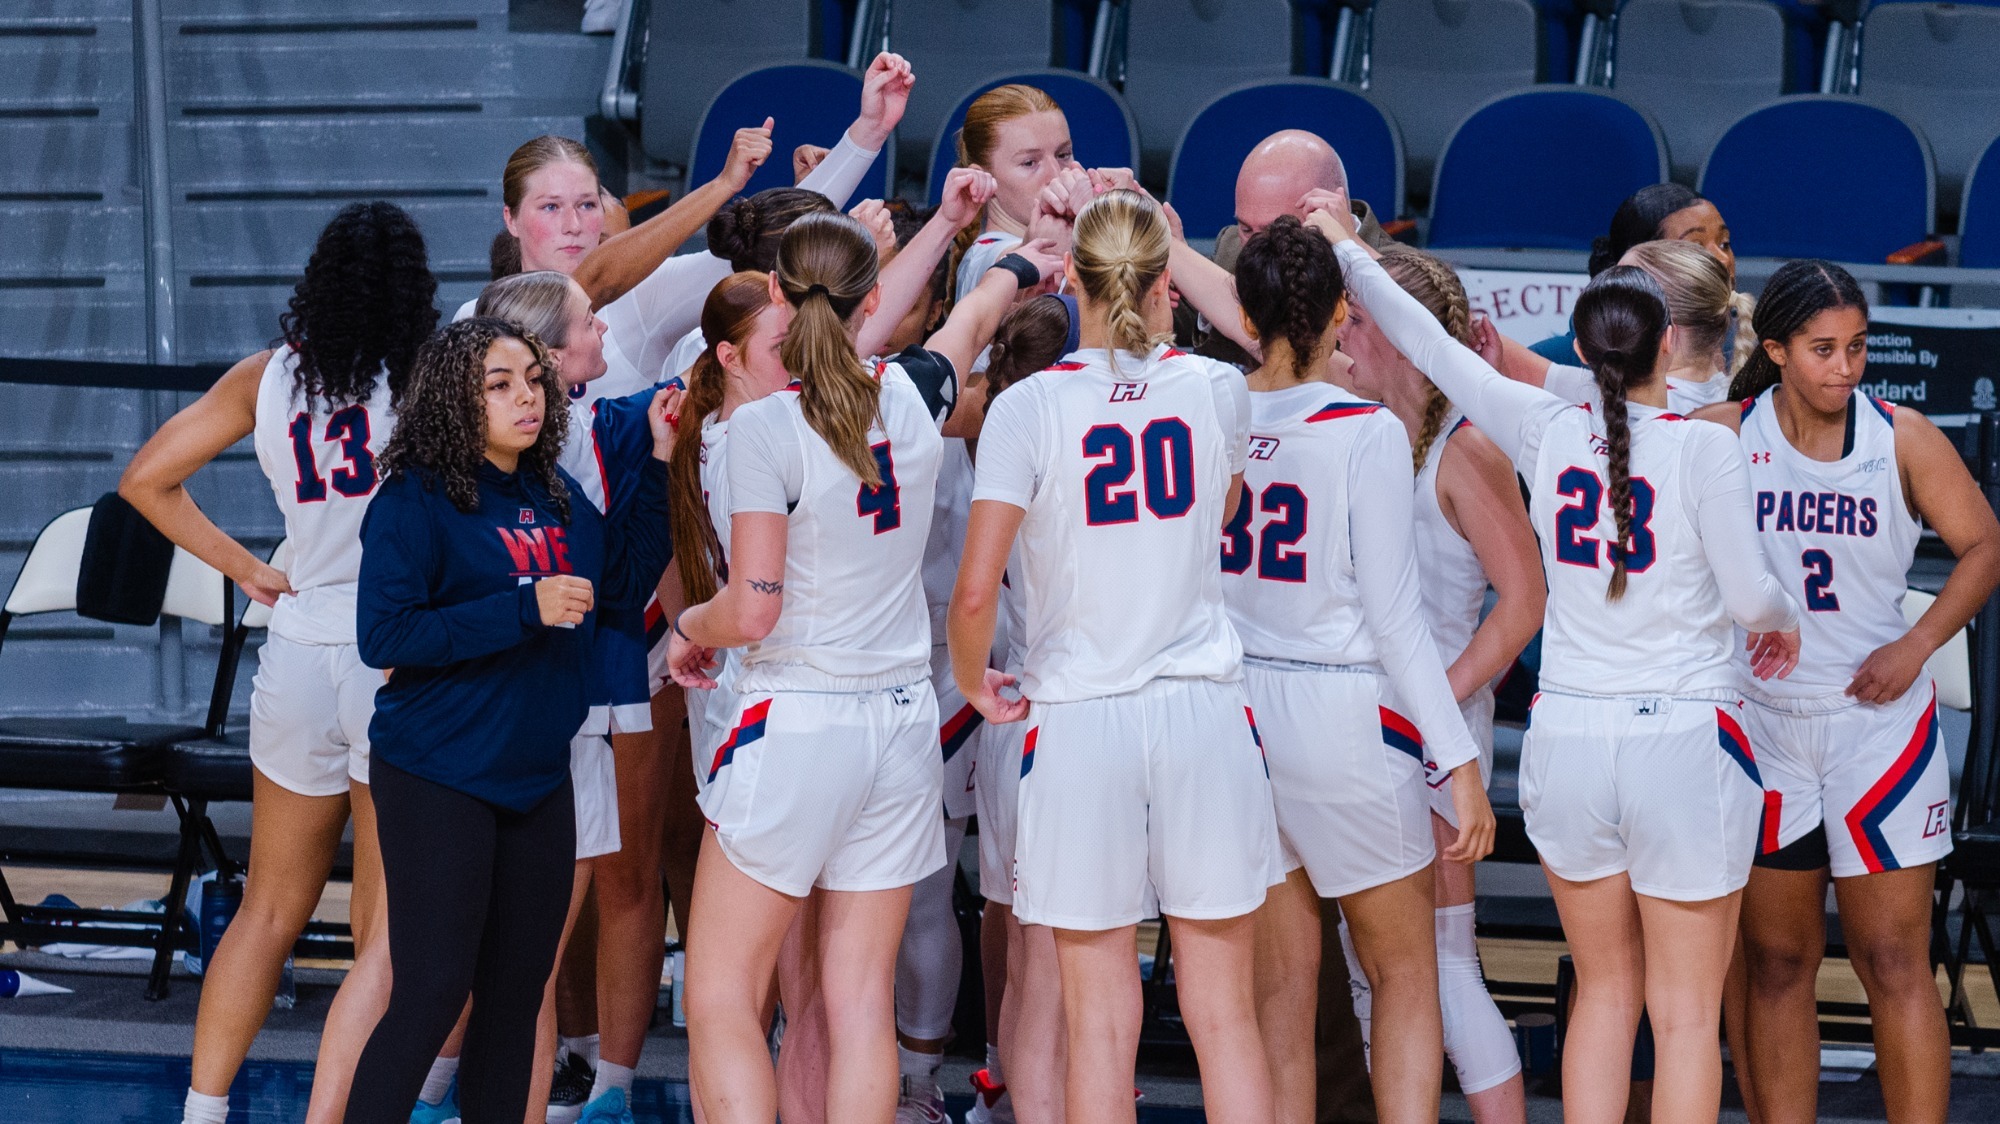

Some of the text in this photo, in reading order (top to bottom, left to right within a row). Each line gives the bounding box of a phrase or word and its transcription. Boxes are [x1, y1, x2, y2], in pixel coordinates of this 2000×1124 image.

[1469, 284, 1586, 320] SECT
[1865, 333, 1912, 347] ection
[1866, 350, 1938, 368] ossible By
[1858, 379, 1927, 401] ndard
[288, 404, 379, 503] 13
[1081, 416, 1196, 526] 20
[857, 439, 901, 535] 4
[1756, 490, 1878, 537] PACERS
[1220, 479, 1308, 583] 32
[1555, 465, 1656, 573] 23
[496, 526, 574, 573] WE
[1801, 548, 1840, 612] 2
